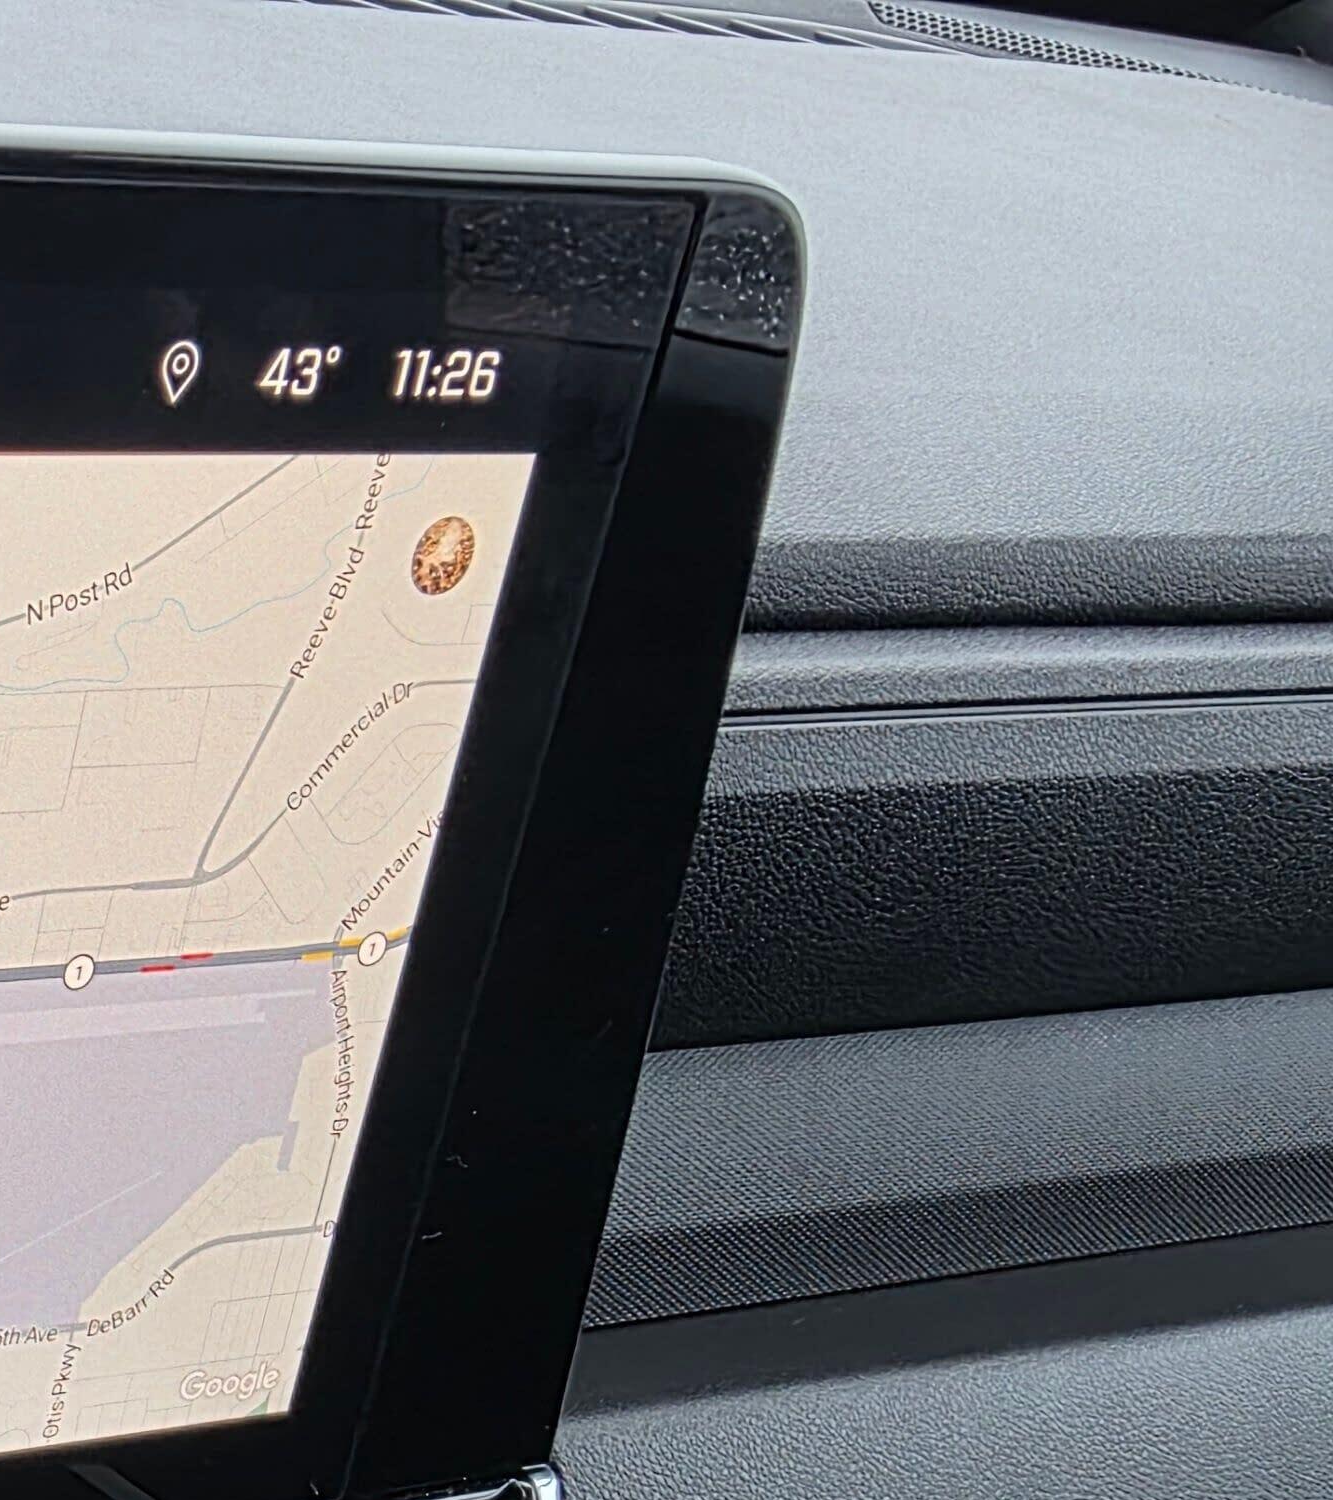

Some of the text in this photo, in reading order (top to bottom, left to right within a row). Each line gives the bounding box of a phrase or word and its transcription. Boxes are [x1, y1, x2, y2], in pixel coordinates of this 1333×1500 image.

[258, 346, 342, 396] 43°
[393, 350, 501, 398] 11:26
[26, 563, 133, 625] N Post Rd
[290, 547, 365, 679] Reeve Blvd
[287, 682, 414, 811] Commercial Dr
[341, 842, 420, 931] Mountain
[330, 970, 354, 1139] Airport Heights Dr
[23, 1326, 58, 1344] Ave
[87, 1270, 175, 1337] DeBarr Rd
[43, 1344, 82, 1439] Otis Pkwy
[180, 1362, 280, 1399] Google
